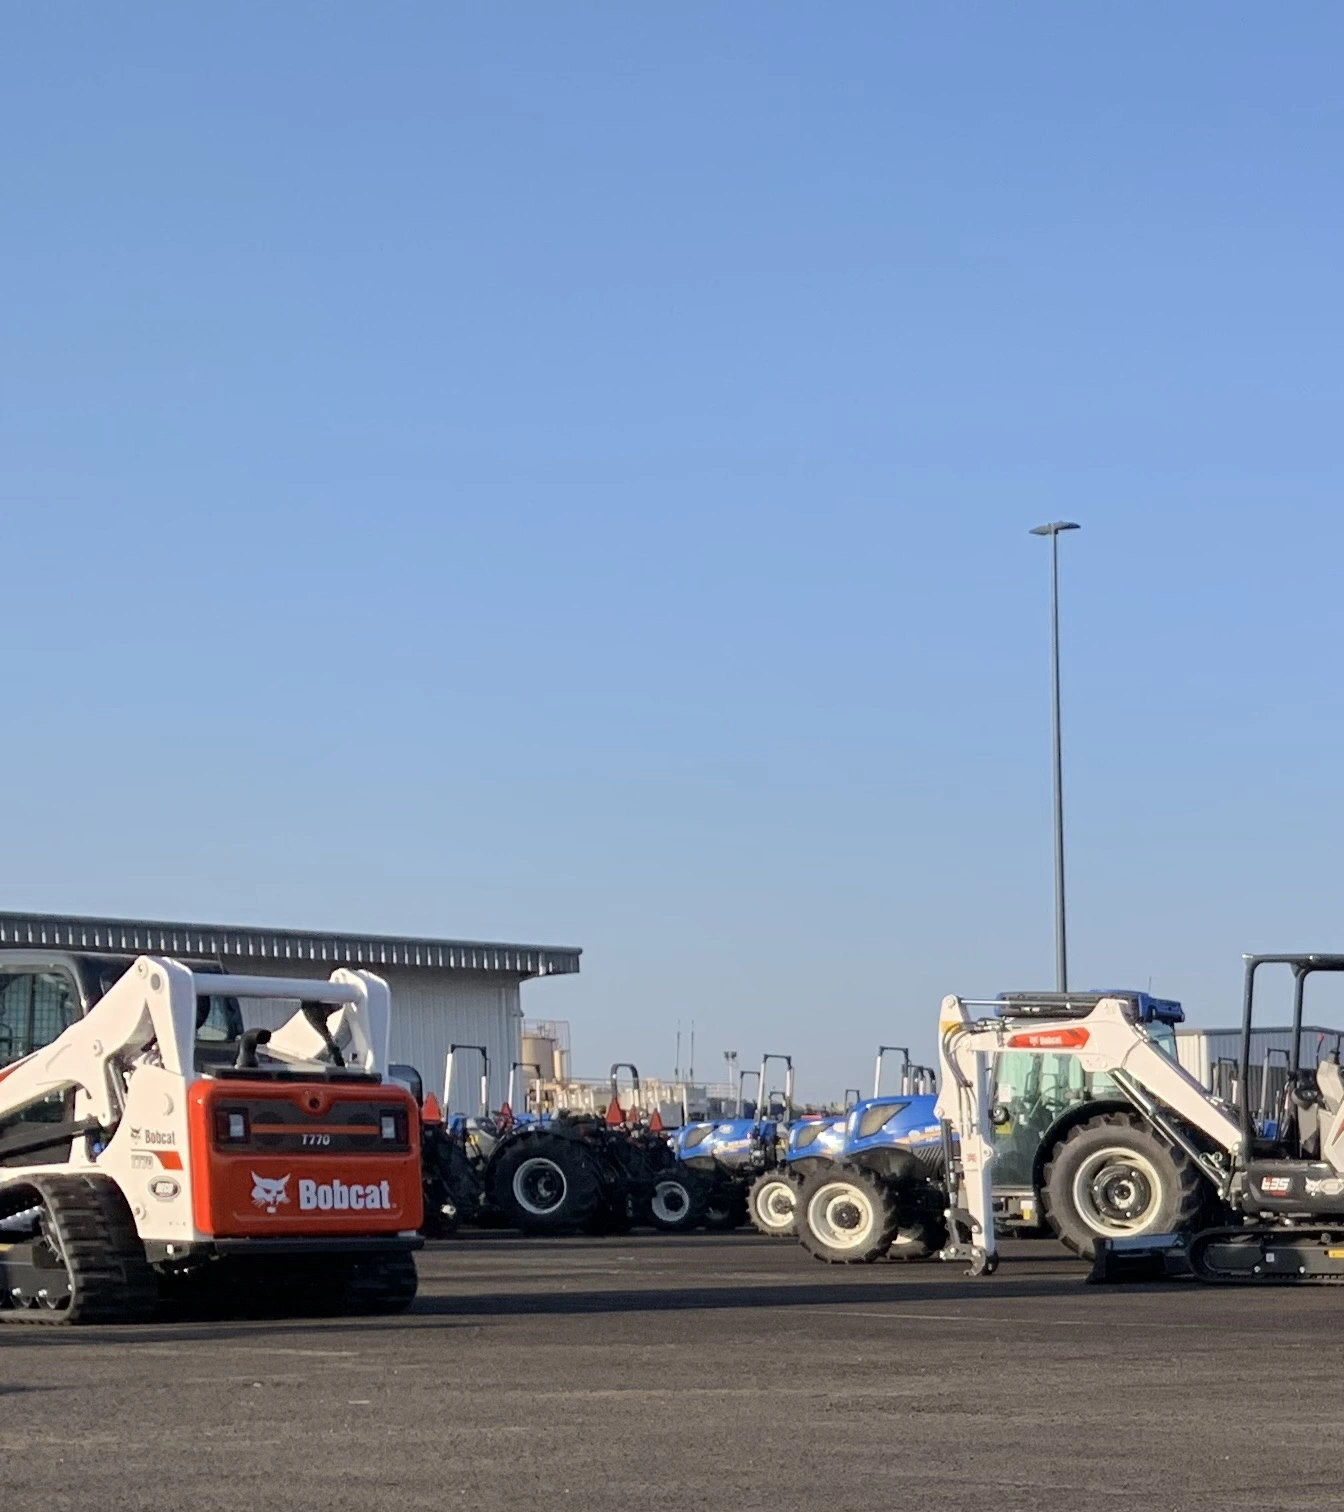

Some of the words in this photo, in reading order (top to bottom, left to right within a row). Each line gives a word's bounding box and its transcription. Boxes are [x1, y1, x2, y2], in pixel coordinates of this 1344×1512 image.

[144, 1129, 175, 1145] Bobcat
[301, 1133, 331, 1146] T770
[299, 1179, 391, 1210] Bobcat
